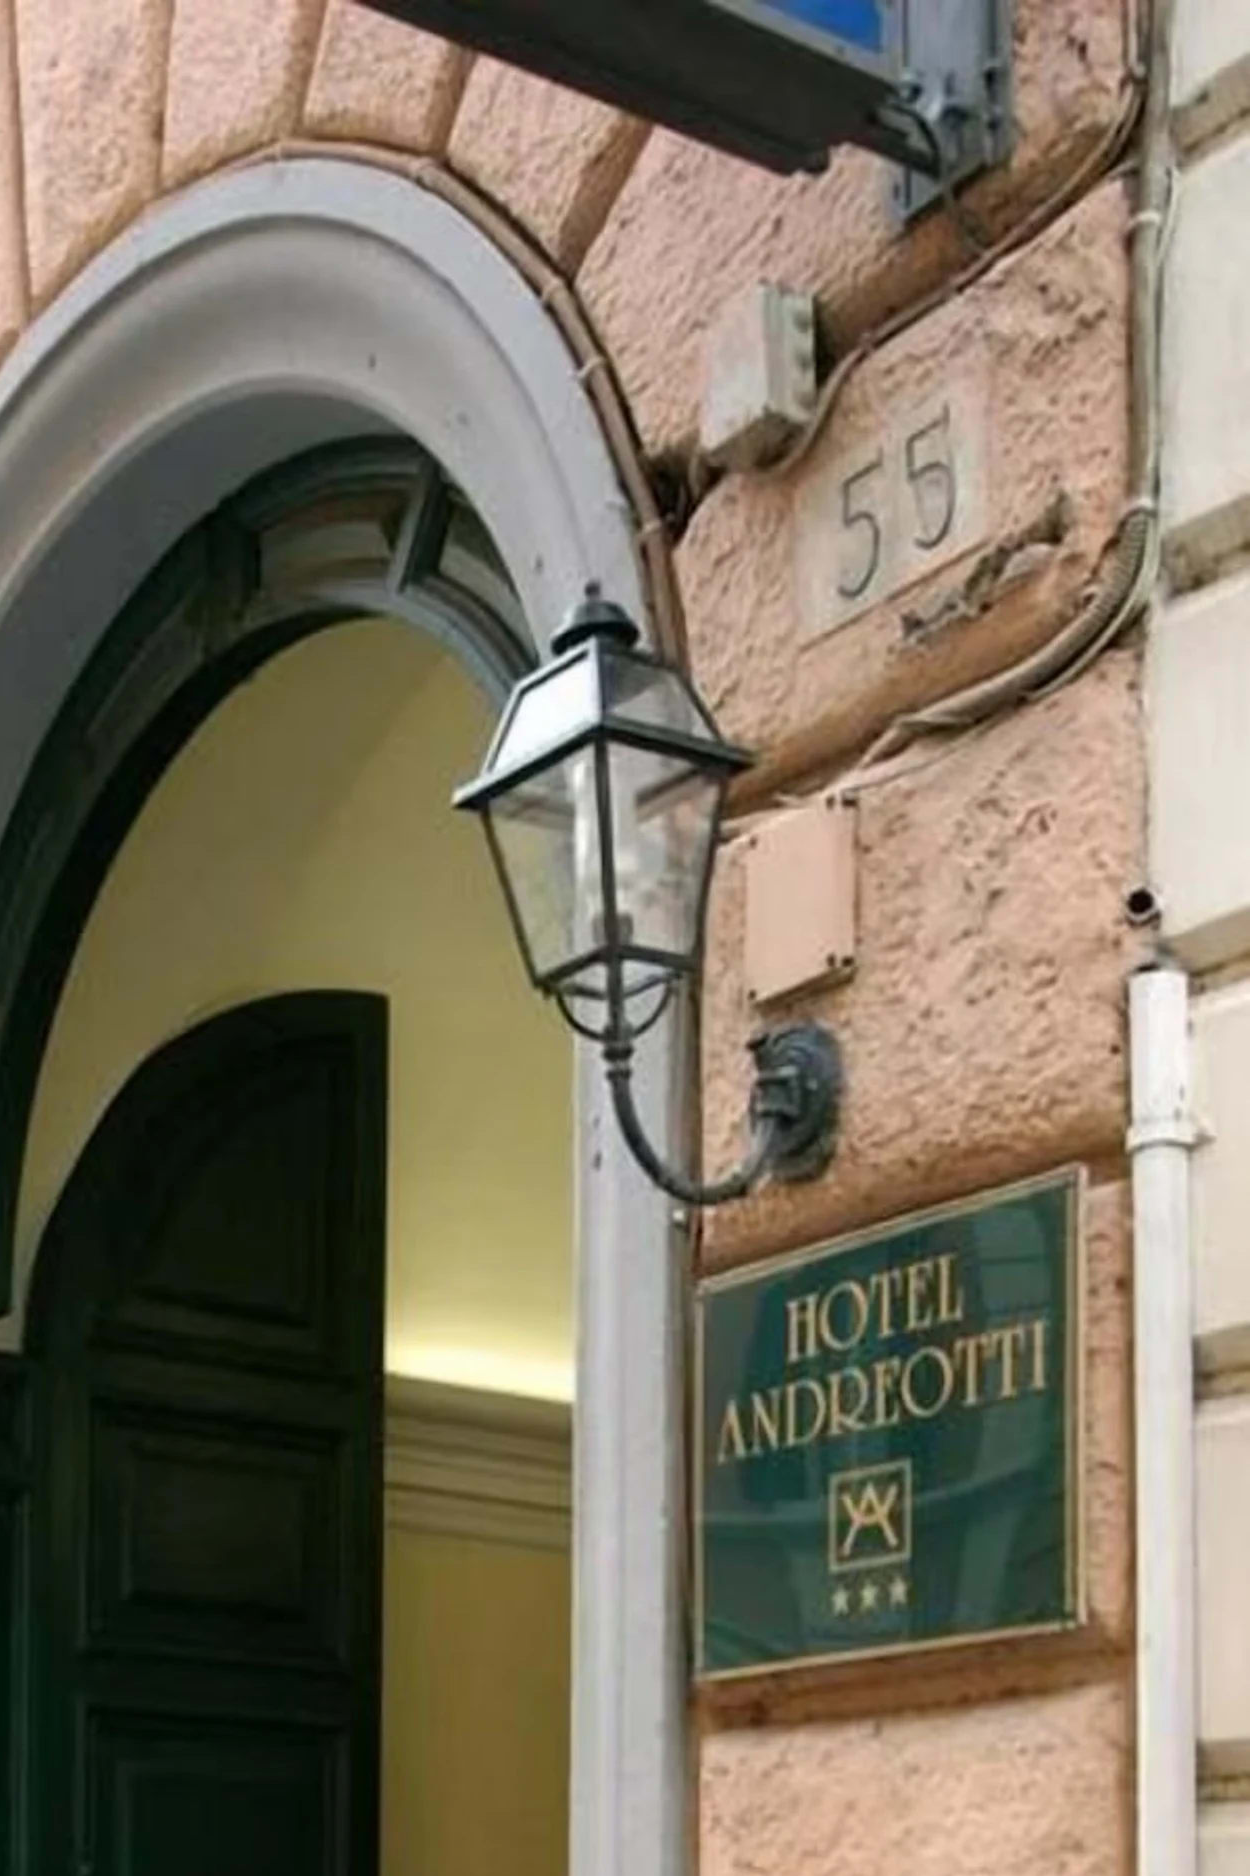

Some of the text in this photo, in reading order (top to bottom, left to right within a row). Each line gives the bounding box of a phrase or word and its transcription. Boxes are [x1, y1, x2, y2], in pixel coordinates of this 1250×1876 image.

[837, 404, 957, 600] 55
[785, 1253, 965, 1363] HOTEL
[717, 1319, 1047, 1465] ANDREOTTI
